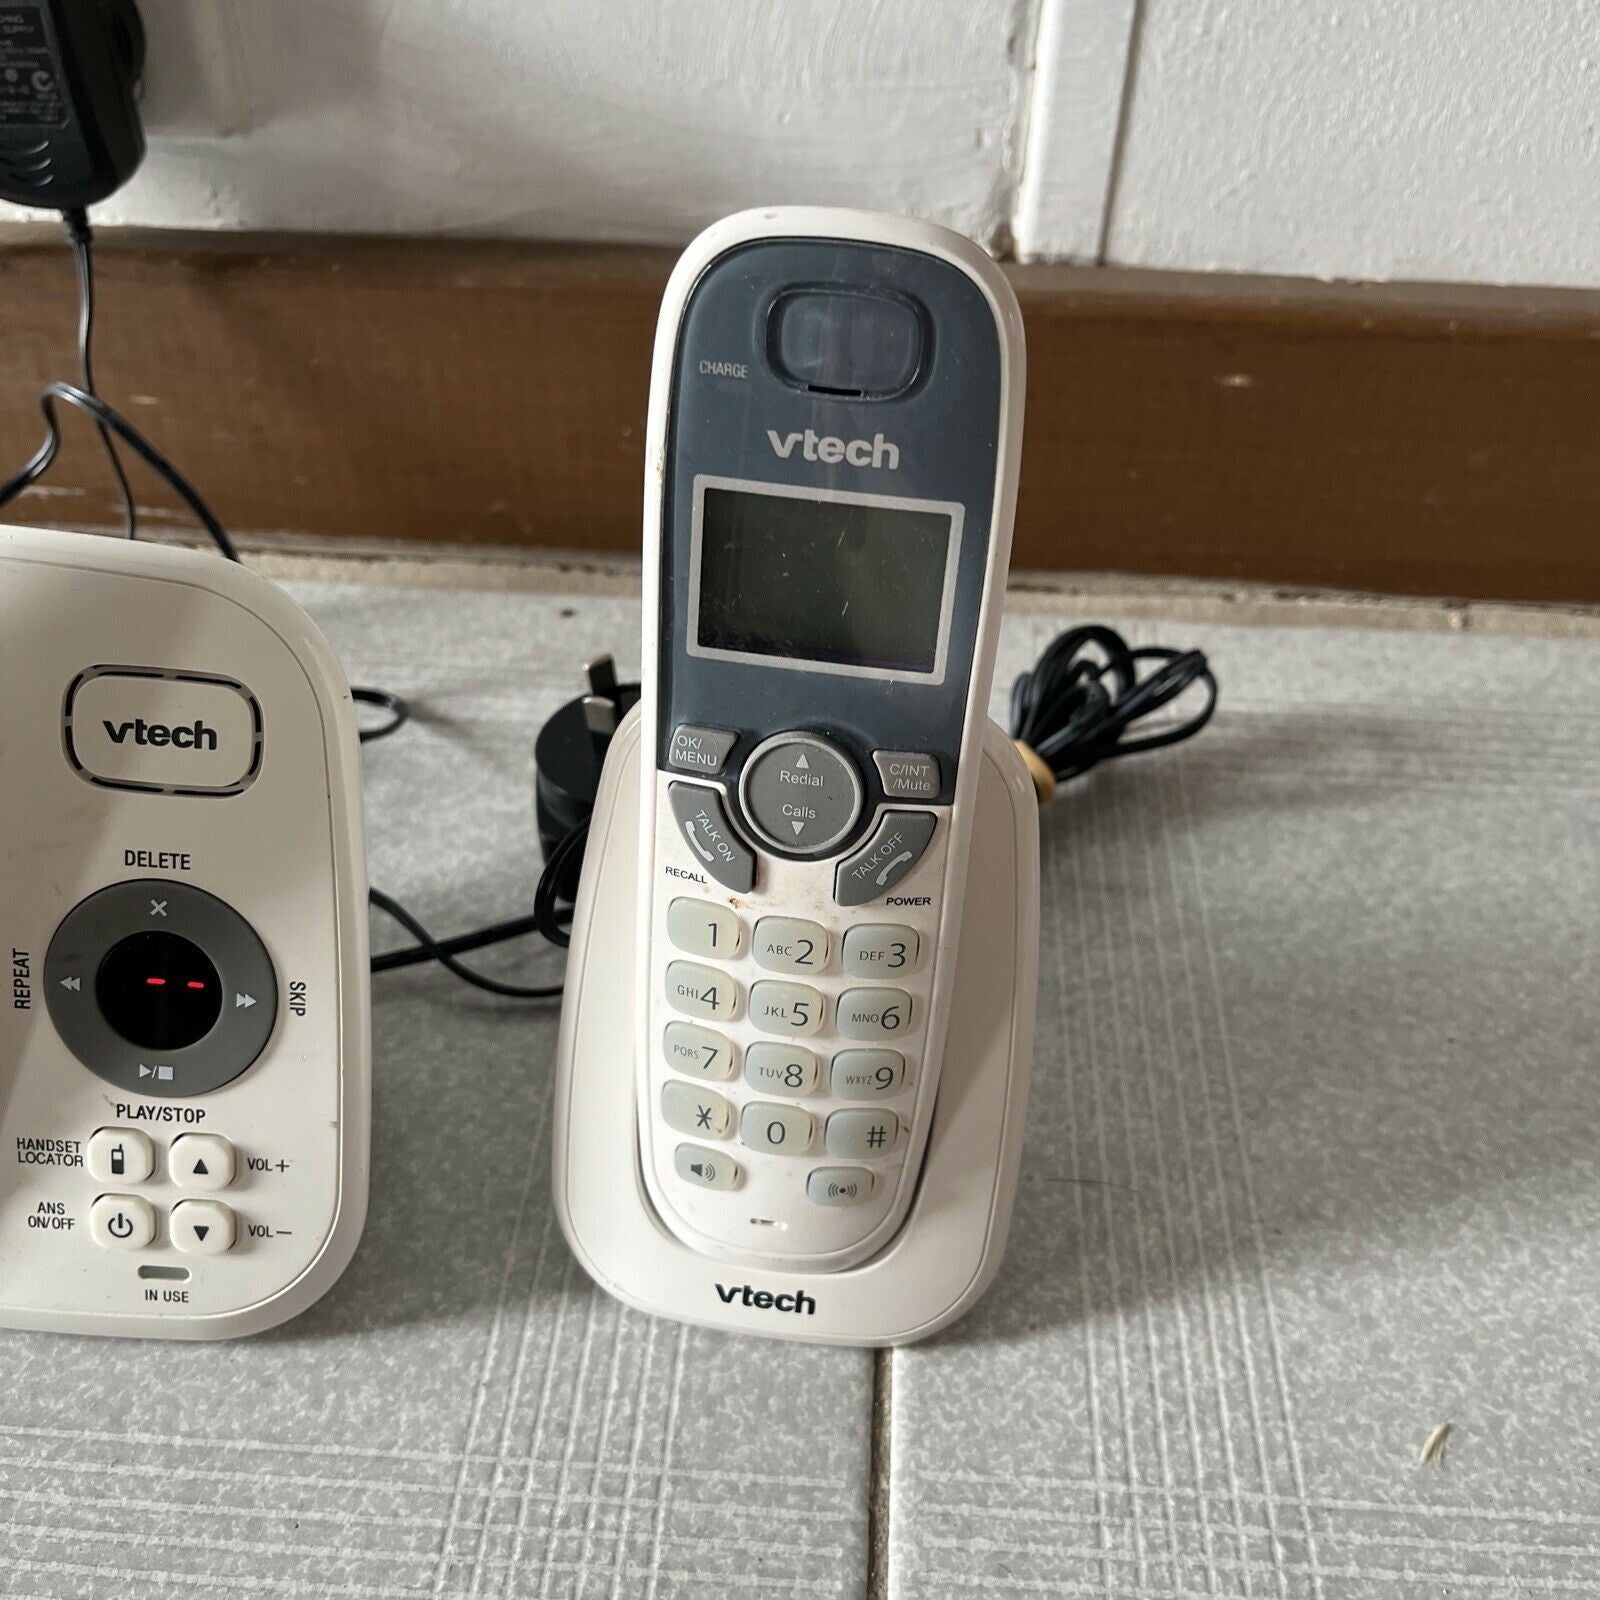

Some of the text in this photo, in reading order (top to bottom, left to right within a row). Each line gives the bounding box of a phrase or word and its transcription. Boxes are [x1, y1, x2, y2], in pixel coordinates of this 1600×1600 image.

[699, 360, 748, 379] CHARGE
[766, 428, 900, 470] vtech
[102, 718, 218, 750] vtech
[676, 735, 702, 751] OK/
[674, 750, 718, 767] MENU
[889, 763, 930, 776] C/INT
[779, 770, 824, 787] Redial
[782, 804, 816, 819] Calls
[695, 809, 736, 864] TALK ON
[124, 849, 191, 870] DELETE
[851, 831, 905, 881] TALK OFF
[665, 866, 708, 884] RECALL
[886, 896, 932, 907] POWER
[707, 922, 718, 948] 1
[766, 939, 815, 965] ABC 2
[859, 943, 907, 968] DEF 3
[14, 948, 31, 1010] REPEAT
[289, 980, 306, 1017] SKIP
[676, 984, 720, 1011] GHI 4
[763, 1002, 810, 1027] JKL 5
[851, 1006, 901, 1030] MNO 6
[673, 1044, 719, 1070] PQRS 7
[759, 1063, 804, 1088] TUV 8
[845, 1066, 895, 1090] WXYZ 9
[115, 1103, 207, 1124] PLAY/STOP
[16, 1137, 82, 1154] HANDSET
[17, 1151, 84, 1168] LOCATOR
[36, 1202, 66, 1216] ANS
[27, 1217, 76, 1231] ON/OFF
[144, 1289, 190, 1304] IN USE
[714, 1283, 817, 1316] vtech
